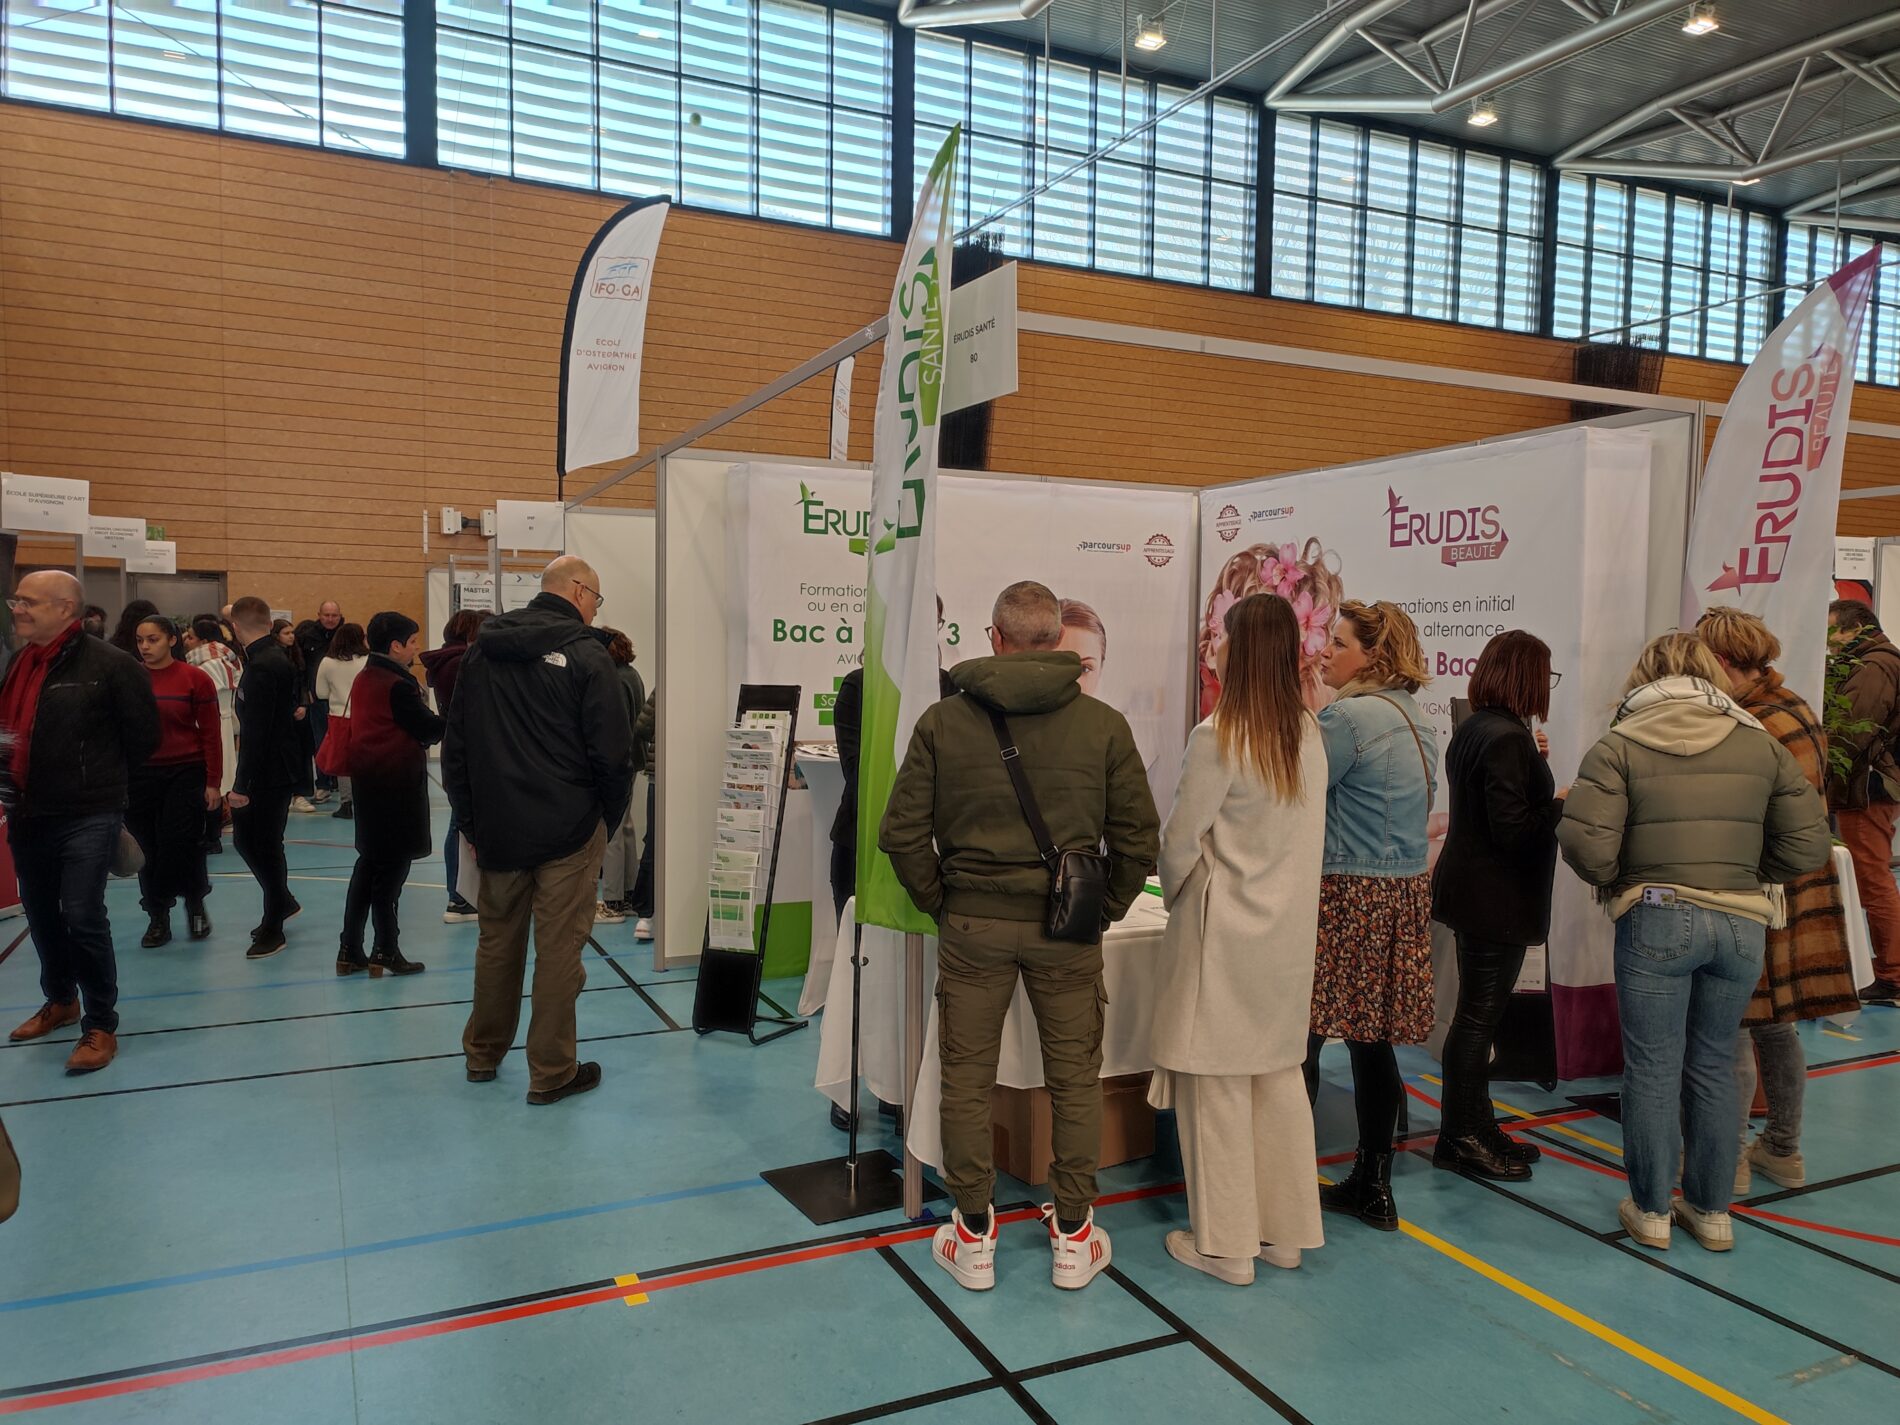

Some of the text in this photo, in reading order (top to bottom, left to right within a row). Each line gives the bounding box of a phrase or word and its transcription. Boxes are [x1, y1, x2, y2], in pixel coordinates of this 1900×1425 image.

[594, 282, 641, 297] IFO-GA
[953, 315, 996, 345] ÉRUDIS SANTÉ
[970, 352, 978, 364] 80
[28, 497, 65, 506] D'AVIGNON
[1252, 506, 1295, 521] parcoursup
[1081, 541, 1132, 553] parcoursup
[1450, 542, 1497, 561] BEAUTÉ
[807, 601, 866, 613] ou en al
[1452, 600, 1471, 614] en
[1476, 594, 1515, 613] initial
[773, 619, 826, 644] Bac
[836, 617, 853, 644] à
[946, 622, 961, 646] 3
[1423, 621, 1505, 638] alternance
[972, 1261, 993, 1271] adida
